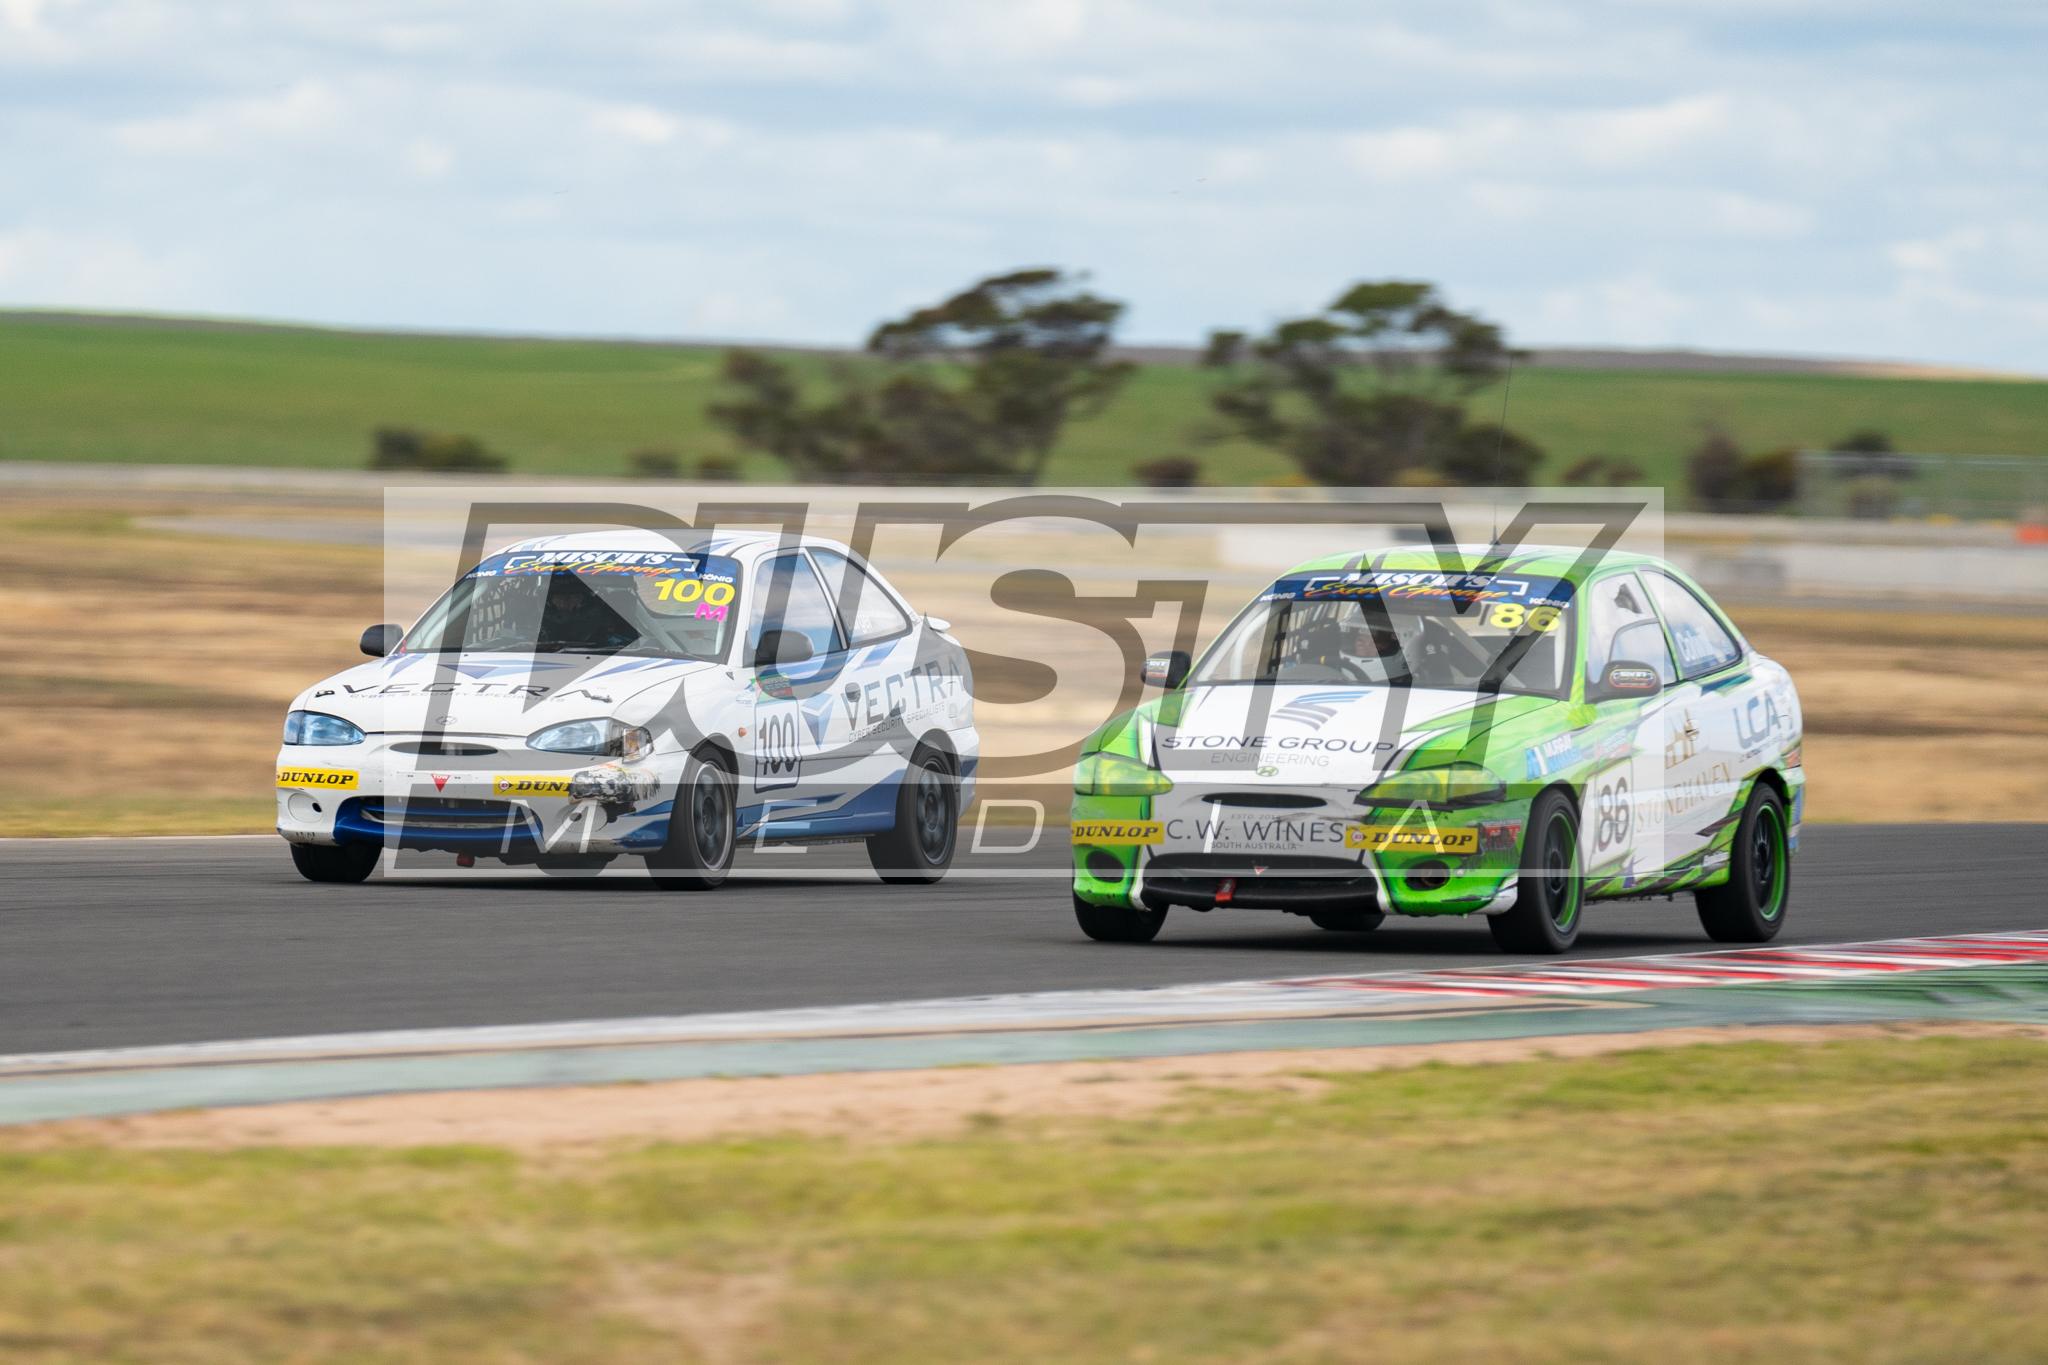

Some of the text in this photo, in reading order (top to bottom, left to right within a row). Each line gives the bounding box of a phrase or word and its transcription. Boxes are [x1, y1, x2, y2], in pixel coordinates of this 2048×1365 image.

[654, 578, 736, 606] 100
[694, 603, 729, 622] M
[1490, 603, 1561, 632] 86
[841, 655, 964, 731] VECTRA
[759, 713, 796, 776] 100
[1162, 735, 1394, 755] STONE GROUP
[1210, 752, 1331, 767] ENGINEERING
[280, 772, 354, 785] DUNLOP
[1597, 776, 1630, 851] 86
[1075, 825, 1159, 838] DUNLOP
[1166, 818, 1344, 843] C.W. WINES
[1372, 831, 1473, 847] DUNLOP
[1211, 841, 1298, 851] SOUTH AUSTRALIA
